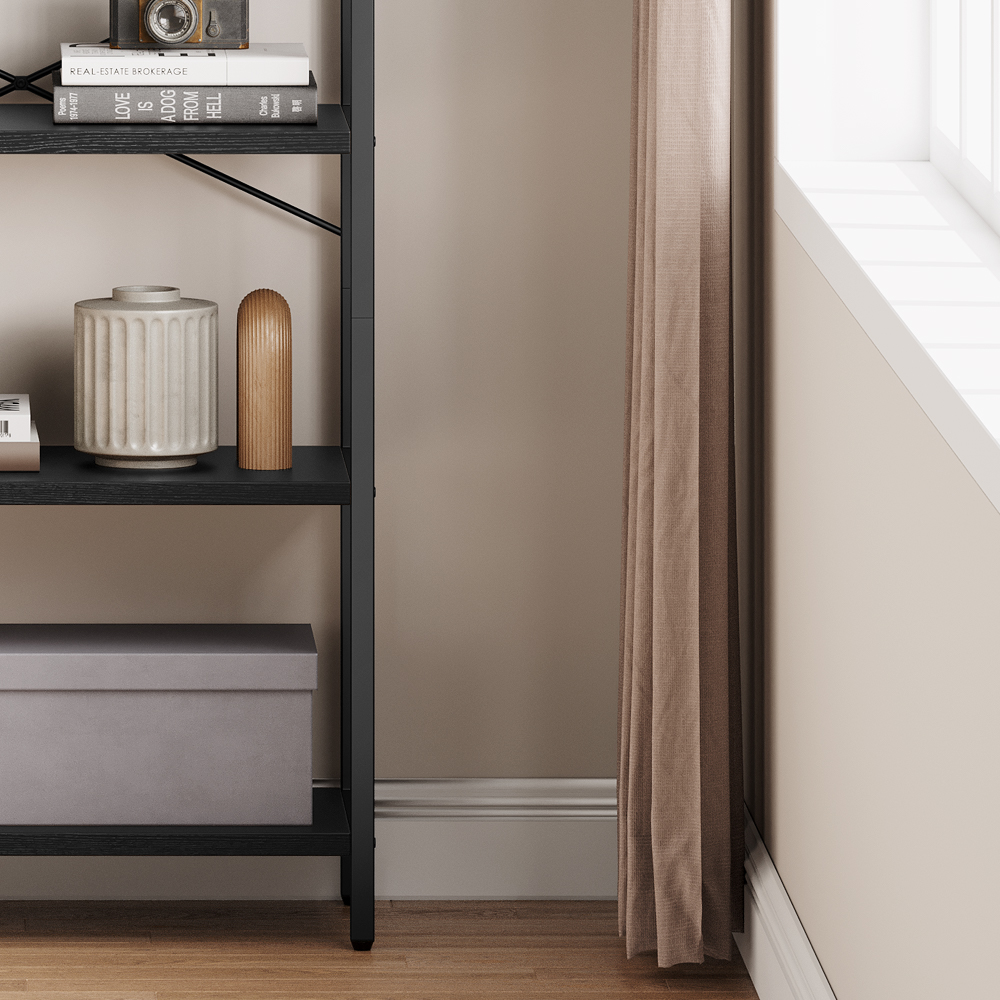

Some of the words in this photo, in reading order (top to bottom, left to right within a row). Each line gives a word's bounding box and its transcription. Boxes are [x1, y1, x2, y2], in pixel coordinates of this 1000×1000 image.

[70, 68, 129, 76] REAL-ESTATE
[132, 68, 188, 76] BROKERAGE
[58, 98, 66, 116] Poems
[70, 92, 78, 120] 1974-1977
[115, 92, 130, 120] LOVE
[138, 102, 153, 111] IS
[160, 90, 176, 110] DOG
[184, 92, 198, 121] FROM
[207, 92, 221, 119] HELL
[259, 96, 267, 116] Charles
[271, 94, 280, 118] Bukowski
[161, 111, 176, 122] A
